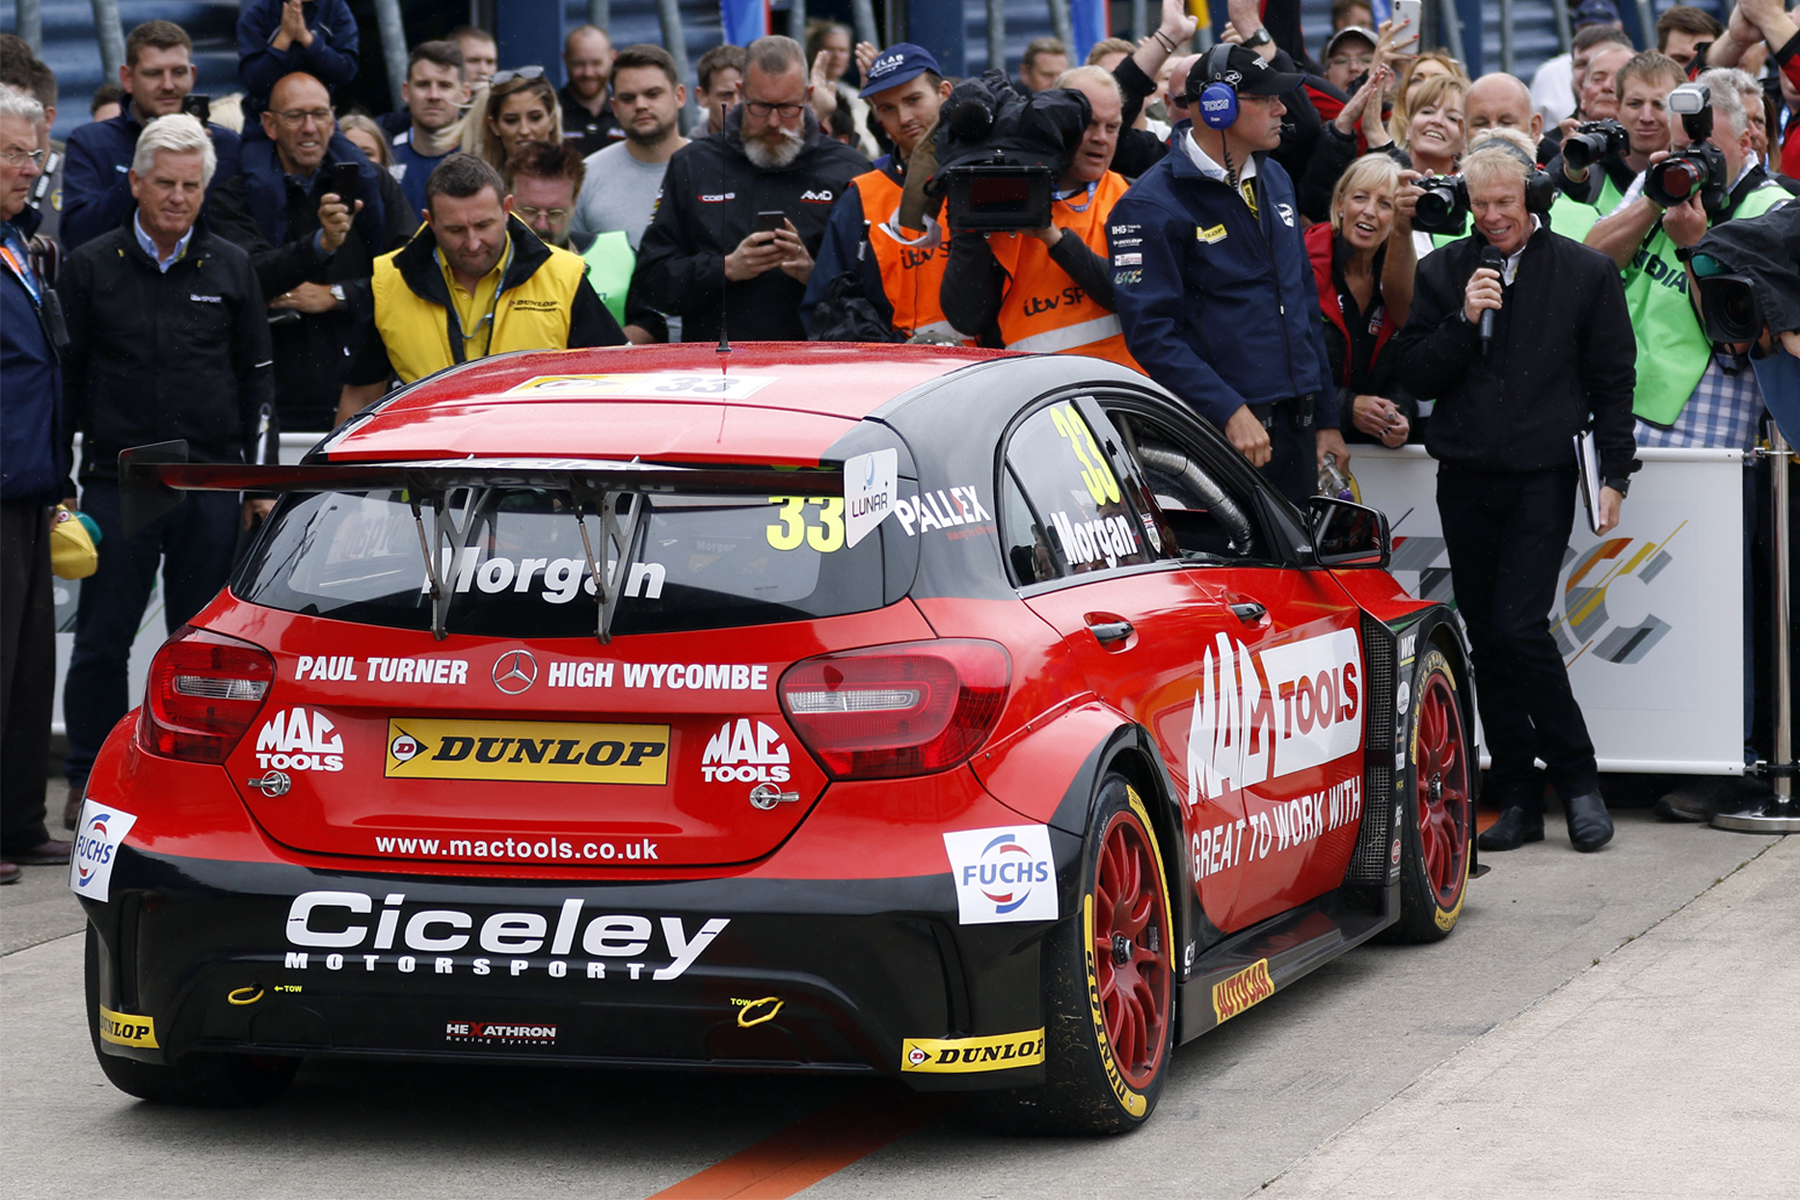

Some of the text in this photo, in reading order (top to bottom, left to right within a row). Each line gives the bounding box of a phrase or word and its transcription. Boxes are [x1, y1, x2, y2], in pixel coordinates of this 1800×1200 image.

[800, 190, 833, 201] AMD
[1024, 297, 1060, 317] itv
[655, 377, 741, 393] 33
[1050, 405, 1121, 506] 33
[851, 492, 889, 518] LUNAR
[893, 485, 991, 537] PALLEX
[766, 496, 845, 553] 33
[1050, 511, 1138, 569] Morgan
[295, 655, 469, 685] PAUL TURNER
[548, 662, 768, 690] HIGH WYCOMBE
[1278, 662, 1359, 740] TOOLS
[256, 707, 344, 753] MAC
[1187, 632, 1270, 806] MAC
[431, 736, 666, 767] DUNLOP
[702, 718, 790, 764] MAC
[256, 753, 344, 772] TOOLS
[701, 766, 791, 783] TOOLS
[1192, 821, 1247, 883] GREAT
[1249, 811, 1273, 862] TO
[1273, 790, 1326, 852] WORK
[1328, 775, 1361, 832] WITH
[76, 835, 114, 865] FUCHS
[375, 836, 659, 860] www.mactools.co.uk
[962, 861, 1049, 886] FUCHS
[285, 890, 732, 981] Ciceley
[284, 952, 645, 980] MOTORSPORT
[1217, 962, 1272, 1020] AUTOCAR
[446, 1022, 557, 1037] HEXATHRON
[446, 1036, 491, 1044] Racing
[1087, 950, 1127, 1101] DUNLOP
